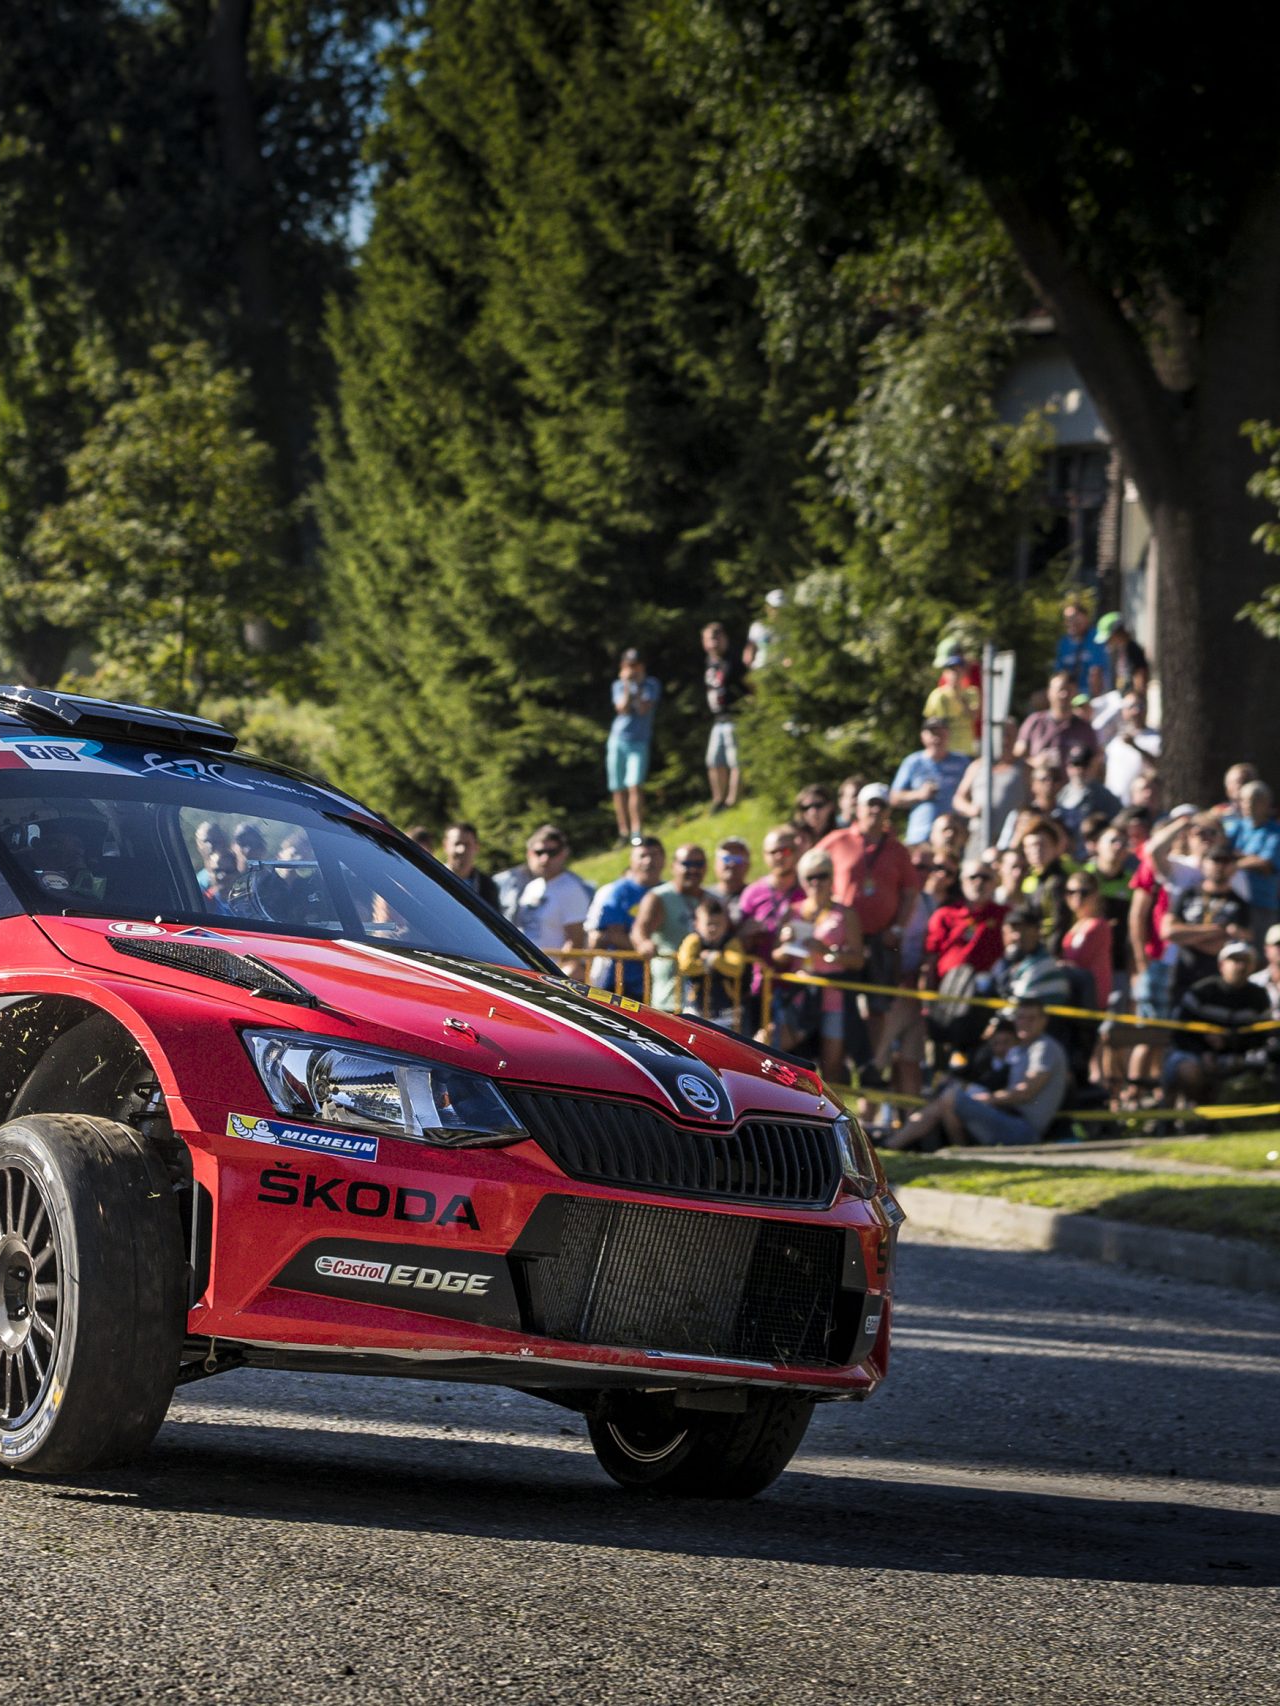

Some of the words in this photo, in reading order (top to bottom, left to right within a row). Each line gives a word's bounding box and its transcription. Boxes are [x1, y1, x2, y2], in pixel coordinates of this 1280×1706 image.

[546, 996, 675, 1057] ŠKODA
[280, 1129, 375, 1152] MICHELIN
[257, 1162, 480, 1231] ŠKODA
[332, 1259, 385, 1280] Castrol
[388, 1264, 495, 1296] EDGE
